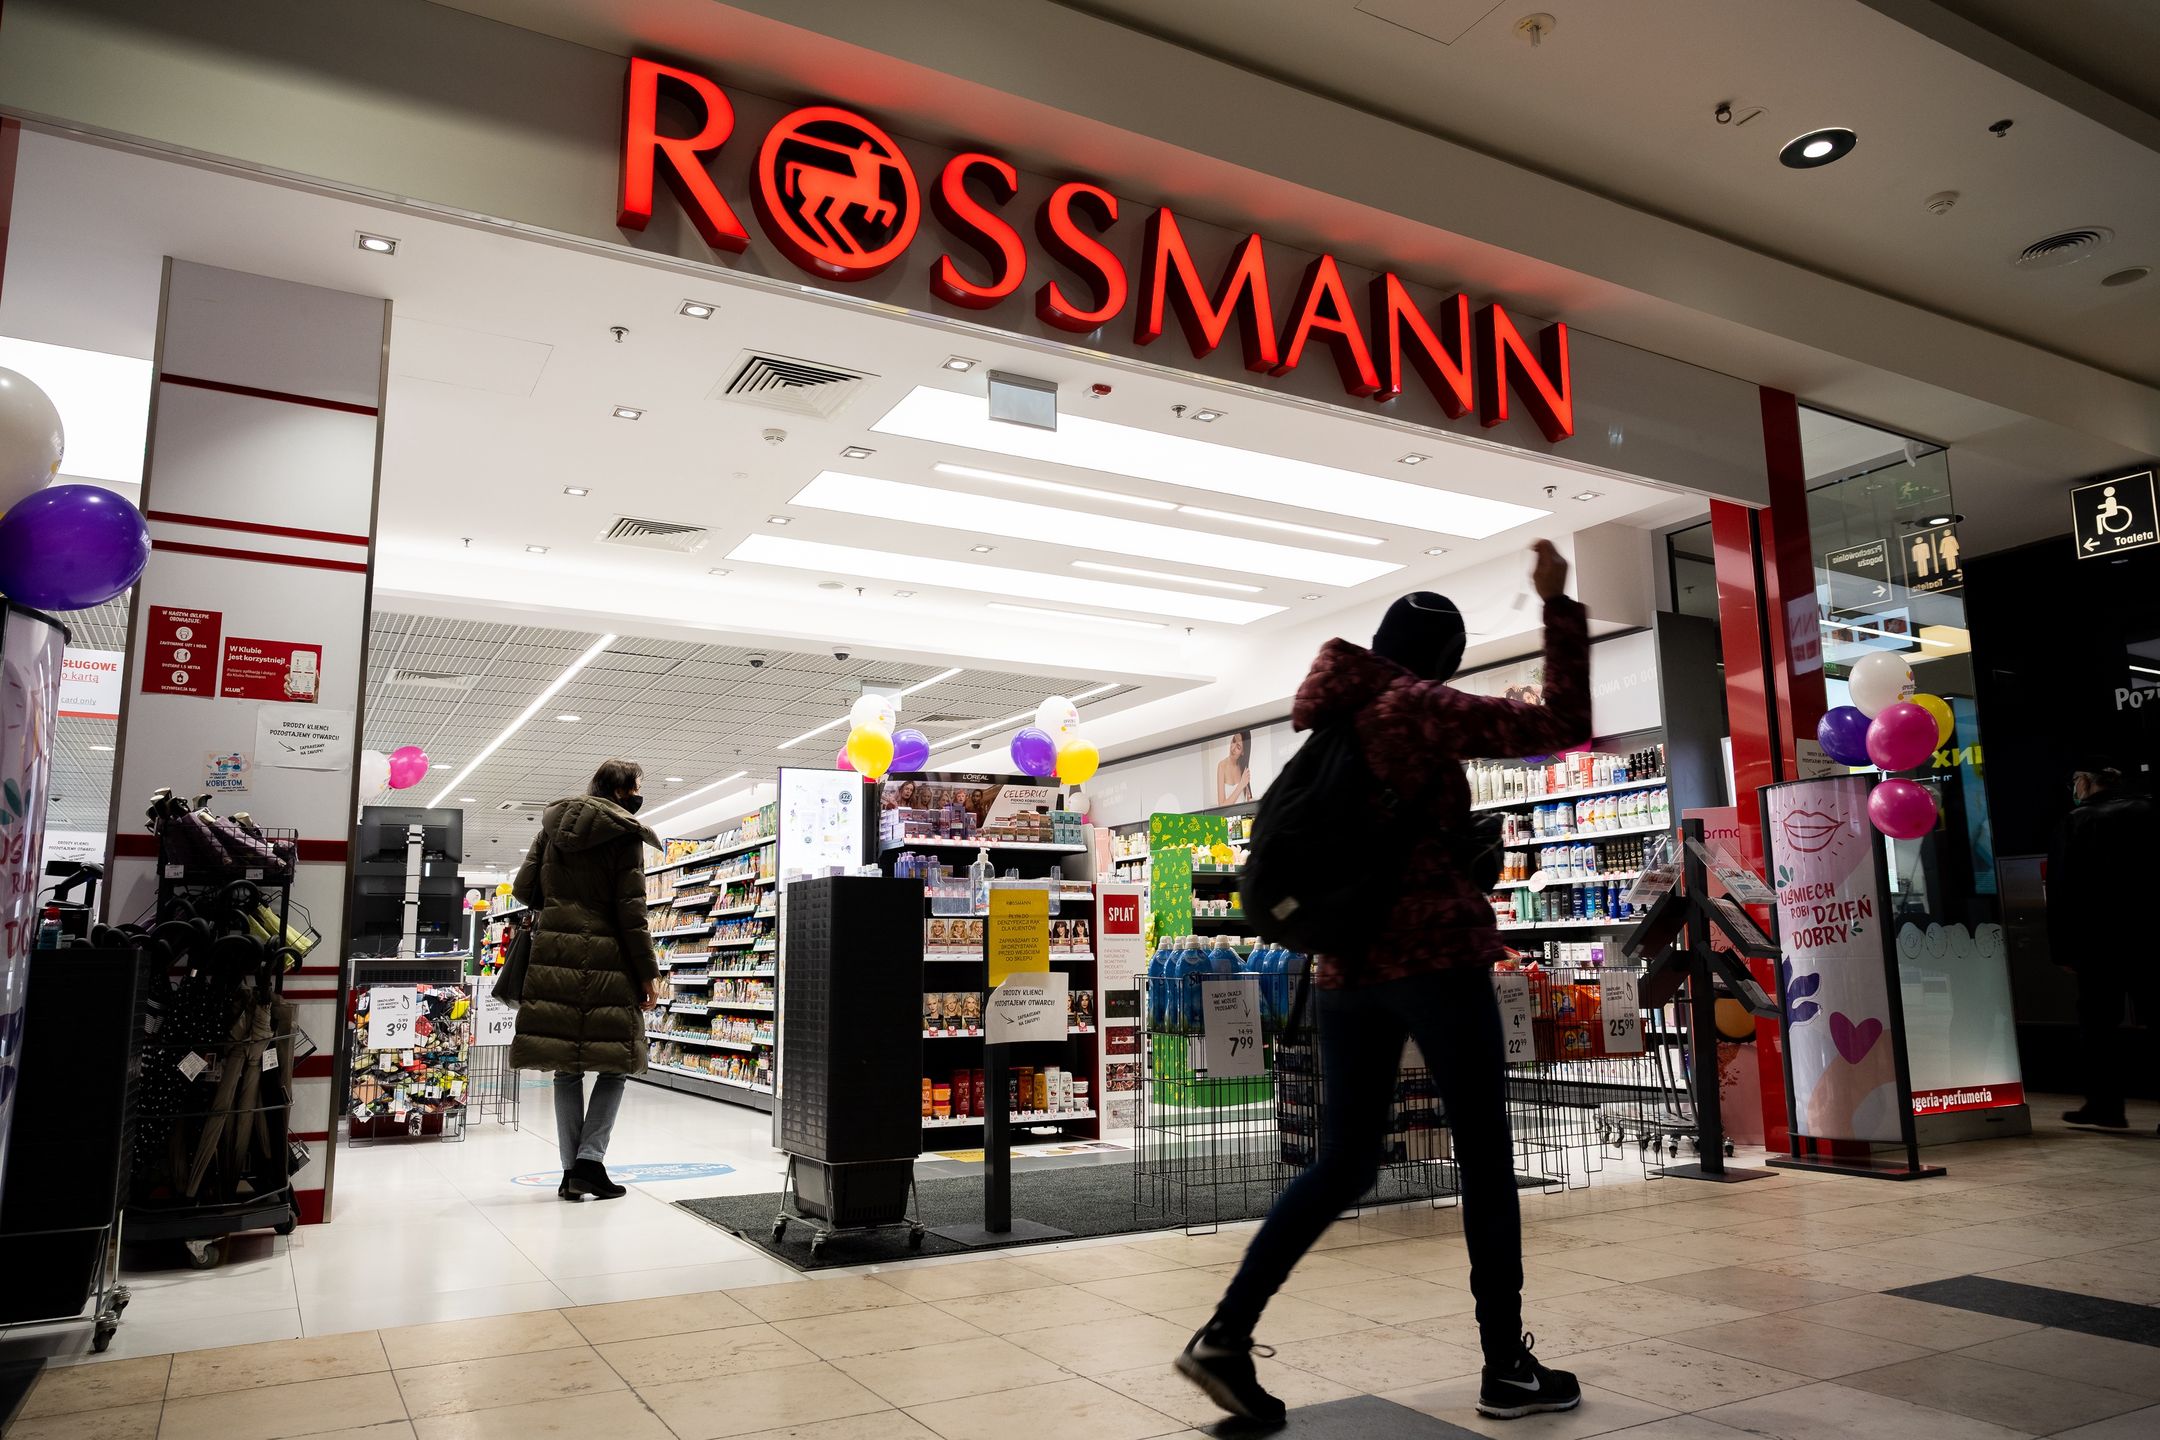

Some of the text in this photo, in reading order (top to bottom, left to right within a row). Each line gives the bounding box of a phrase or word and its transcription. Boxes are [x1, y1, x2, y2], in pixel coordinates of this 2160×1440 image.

[617, 57, 1574, 443] ROSSMANN
[2115, 531, 2154, 546] Toaleta
[239, 646, 262, 654] Klubie
[63, 659, 117, 672] SŁUGOWE
[228, 653, 286, 665] jest korzystniej!
[71, 672, 99, 683] kartą
[283, 721, 329, 732] DRODZY KLIENCI
[269, 729, 310, 739] POZOSTAJEMY
[206, 779, 242, 787] KOBIETOM
[1003, 789, 1048, 799] CELEBRUJ
[1780, 882, 1835, 906] UŚMIECH
[1108, 907, 1134, 922] SPLAT
[1790, 894, 1873, 925] ROBI DZIEŃ
[1792, 924, 1848, 950] DOBRY
[1912, 1088, 1993, 1112] ogeria-perfumeria
